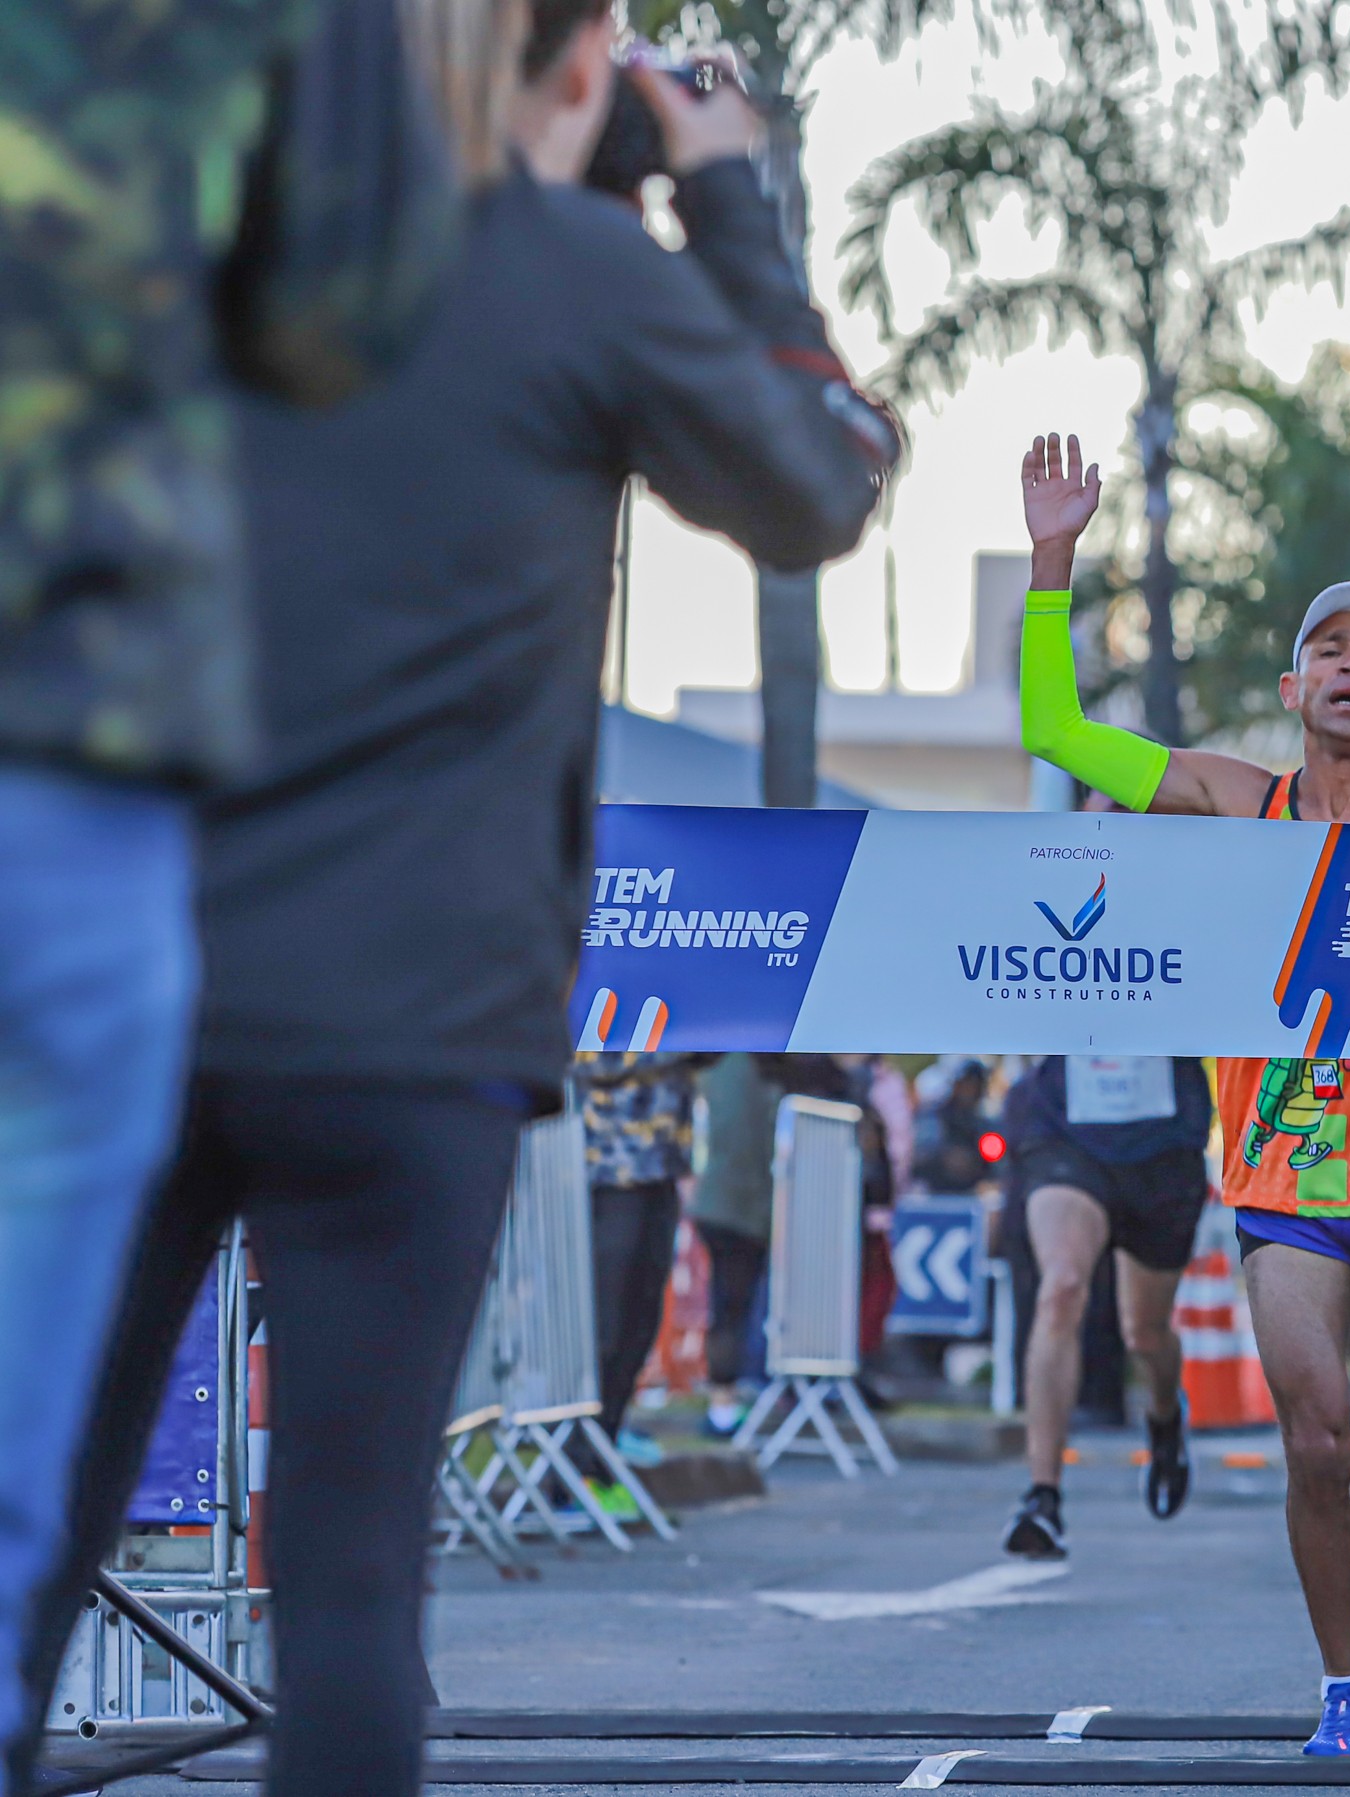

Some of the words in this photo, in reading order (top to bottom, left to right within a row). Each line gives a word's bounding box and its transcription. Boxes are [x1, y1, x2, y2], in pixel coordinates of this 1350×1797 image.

[1029, 846, 1115, 861] PATROCÍNIO:
[594, 867, 675, 904] TEM
[580, 907, 810, 949] RUNNING
[767, 953, 799, 967] ITU
[957, 944, 1183, 984] VISCONDE
[986, 987, 1152, 1001] CONSTRUTORA
